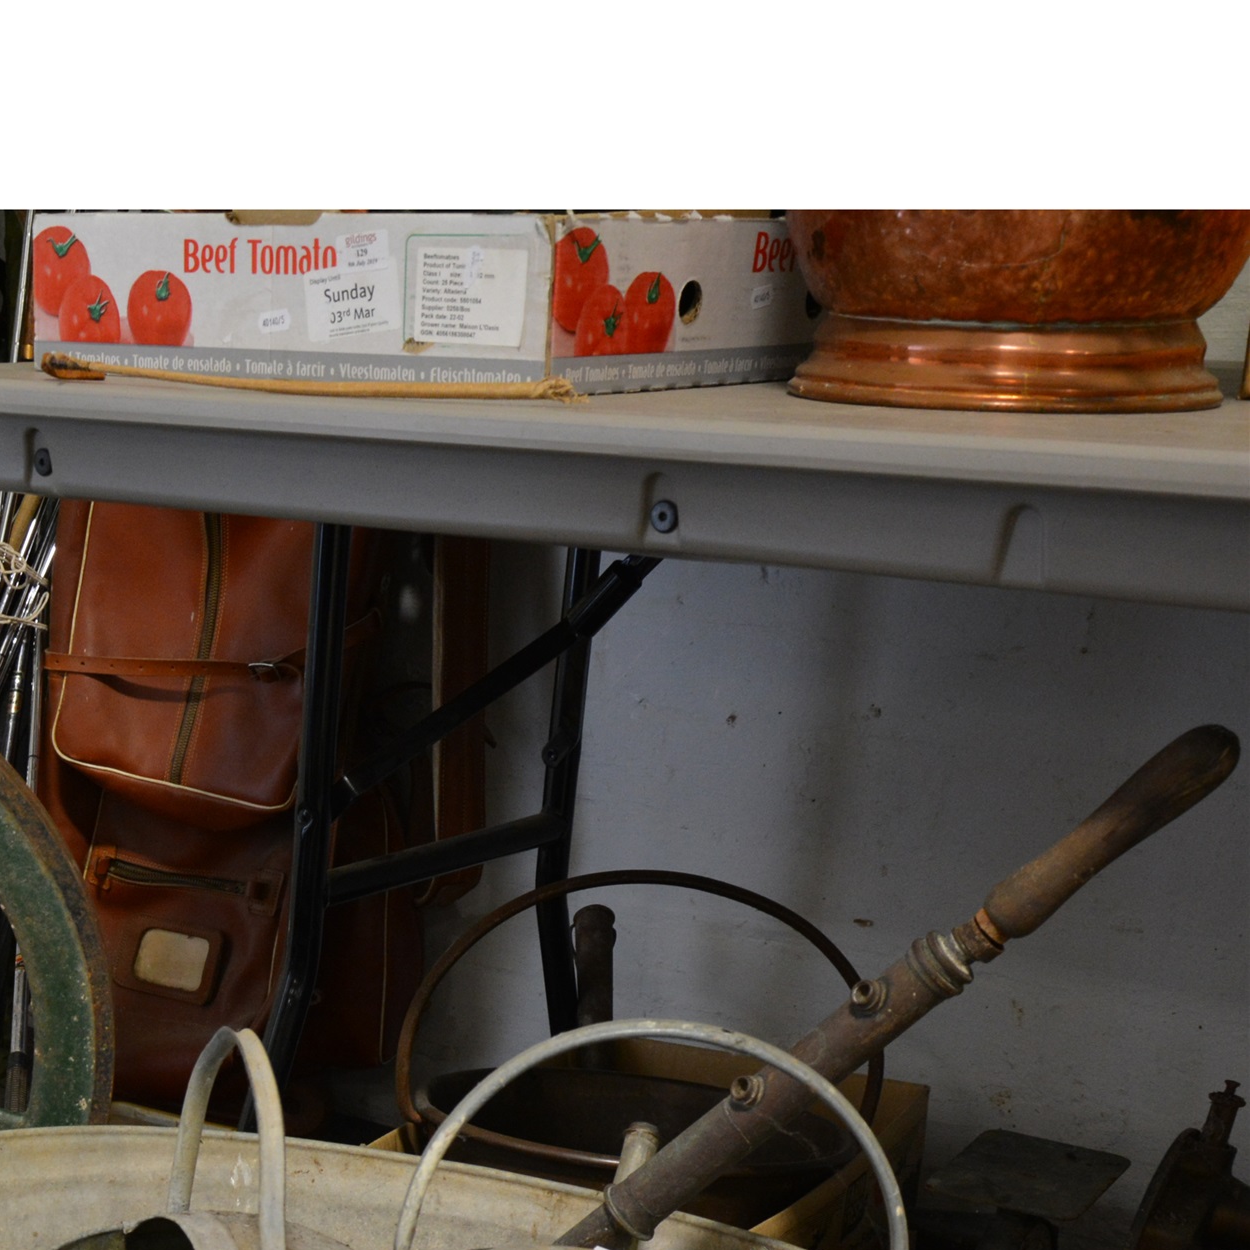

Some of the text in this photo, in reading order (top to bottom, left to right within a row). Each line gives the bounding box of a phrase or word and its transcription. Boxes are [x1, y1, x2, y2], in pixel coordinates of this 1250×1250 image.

[183, 237, 337, 275] Beef Tomato
[356, 248, 368, 257] 129
[324, 283, 375, 303] Sunday
[354, 307, 375, 320] Mar
[132, 354, 168, 371] Tomate
[171, 355, 184, 371] de
[188, 356, 231, 373] ensalada
[245, 359, 283, 375] Tomate
[287, 360, 293, 376] à
[296, 361, 326, 378] farcir
[340, 363, 415, 382] Vleestomaten
[430, 367, 521, 383] Fleischtomaten
[566, 367, 582, 383] Beef
[584, 366, 619, 382] Tomatoes
[627, 364, 654, 380] Tomate
[655, 362, 665, 378] de
[666, 361, 695, 377] ensalada
[703, 359, 726, 375] Tomate
